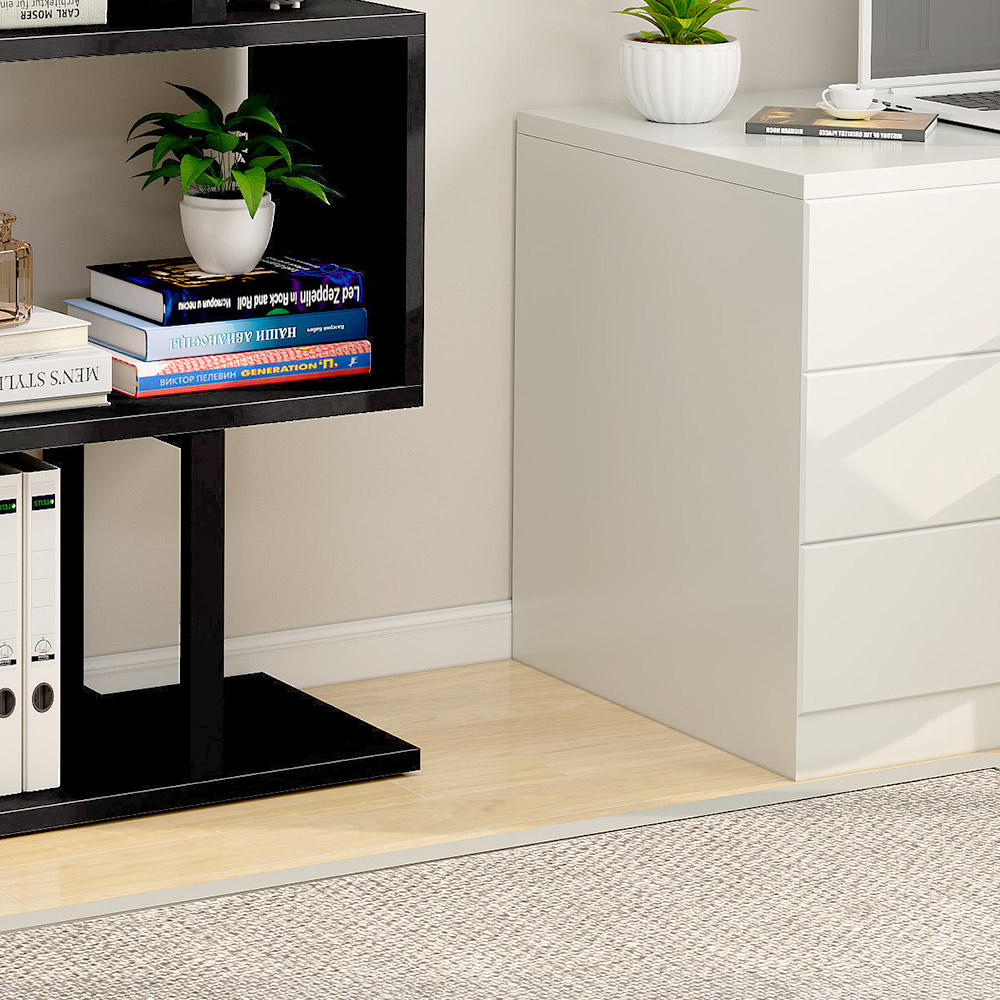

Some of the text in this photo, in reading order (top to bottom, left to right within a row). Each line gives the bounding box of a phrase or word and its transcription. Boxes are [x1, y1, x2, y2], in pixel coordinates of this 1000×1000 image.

[16, 0, 29, 10] für
[20, 8, 80, 20] CARL MOSER
[197, 301, 203, 309] и
[203, 297, 231, 310] История
[237, 285, 360, 311] Led Zeppelin in Rock and Roll
[169, 326, 297, 351] НАШИ АВИАНОСЦЫ
[50, 365, 100, 386] MEN'S
[240, 362, 317, 377] GENERATION
[160, 371, 236, 387] ВИКТОР ПЕЛЕВИН
